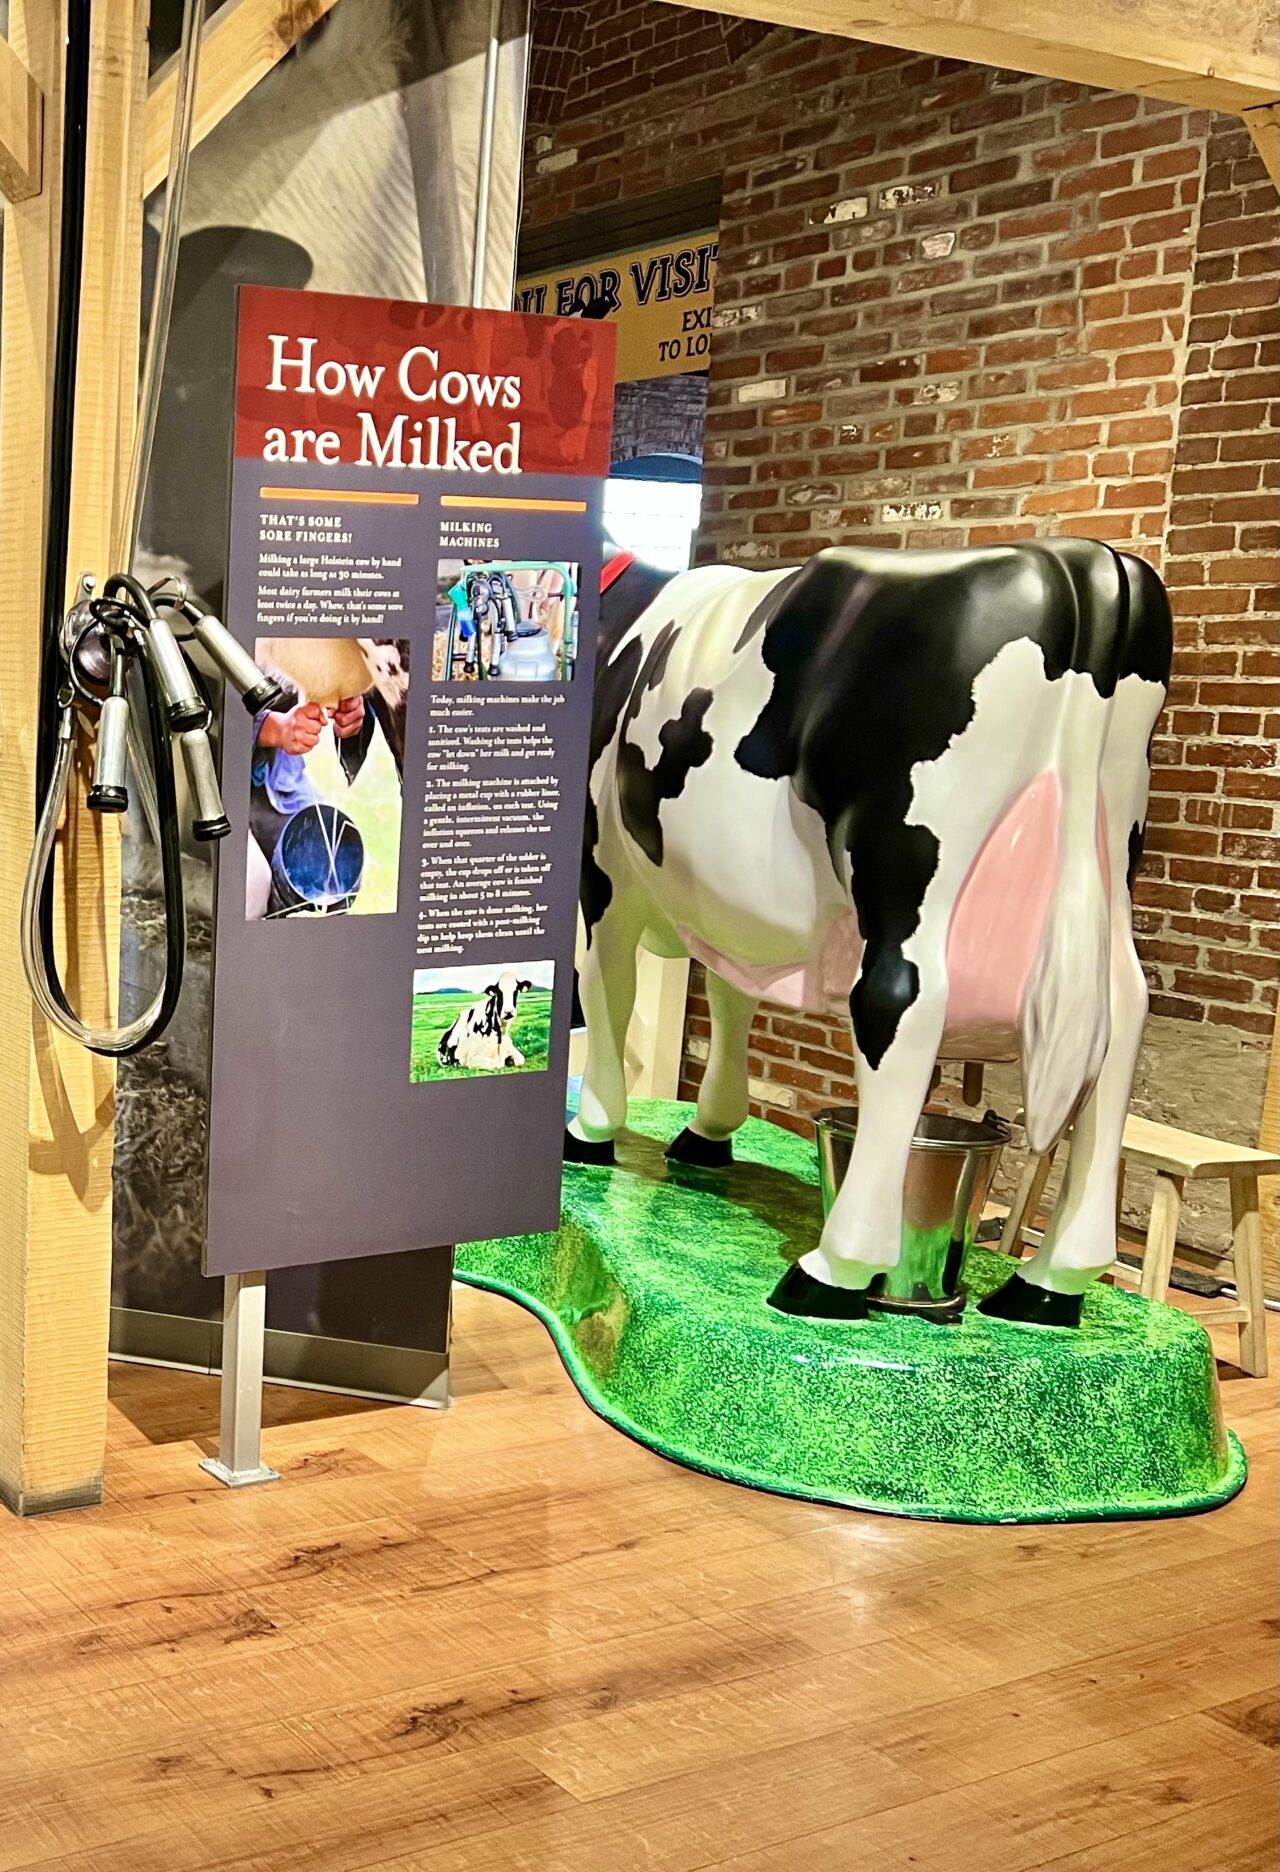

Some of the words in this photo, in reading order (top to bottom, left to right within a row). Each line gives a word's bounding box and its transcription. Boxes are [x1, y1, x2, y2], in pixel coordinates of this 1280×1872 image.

[658, 338, 682, 361] TO
[266, 335, 385, 399] How
[398, 346, 520, 408] Cows
[263, 427, 340, 464] are
[354, 412, 522, 474] Milked
[260, 514, 305, 526] THAT'S
[308, 517, 341, 527] SOME
[440, 522, 492, 533] MILKING
[260, 530, 291, 541] SORE
[296, 531, 352, 543] FINGERS!
[440, 537, 500, 547] MACHINES
[259, 553, 291, 567] Milking
[299, 555, 319, 567] large
[321, 555, 354, 565] Holstein
[372, 557, 380, 568] by
[382, 557, 401, 566] hand
[259, 567, 280, 576] could
[283, 568, 299, 577] take
[310, 568, 327, 580] long
[338, 571, 349, 580] 30
[351, 571, 384, 579] minutes.
[258, 586, 277, 595] Most
[279, 586, 300, 598] dairy
[302, 587, 332, 596] farmers
[334, 588, 351, 596] milk
[354, 588, 372, 597] their
[257, 599, 274, 608] least
[276, 600, 295, 609] twice
[303, 600, 318, 612] day.
[347, 601, 366, 610] that's
[257, 612, 284, 625] fingers
[287, 613, 294, 622] if
[295, 613, 317, 625] you're
[320, 614, 342, 625] doing
[351, 614, 360, 625] by
[456, 695, 485, 706] milking
[486, 695, 520, 703] machines
[521, 695, 540, 703] make
[553, 695, 565, 705] job
[430, 708, 450, 716] much
[438, 725, 453, 733] The
[505, 724, 530, 732] washed
[511, 748, 524, 756] and
[436, 779, 450, 787] The
